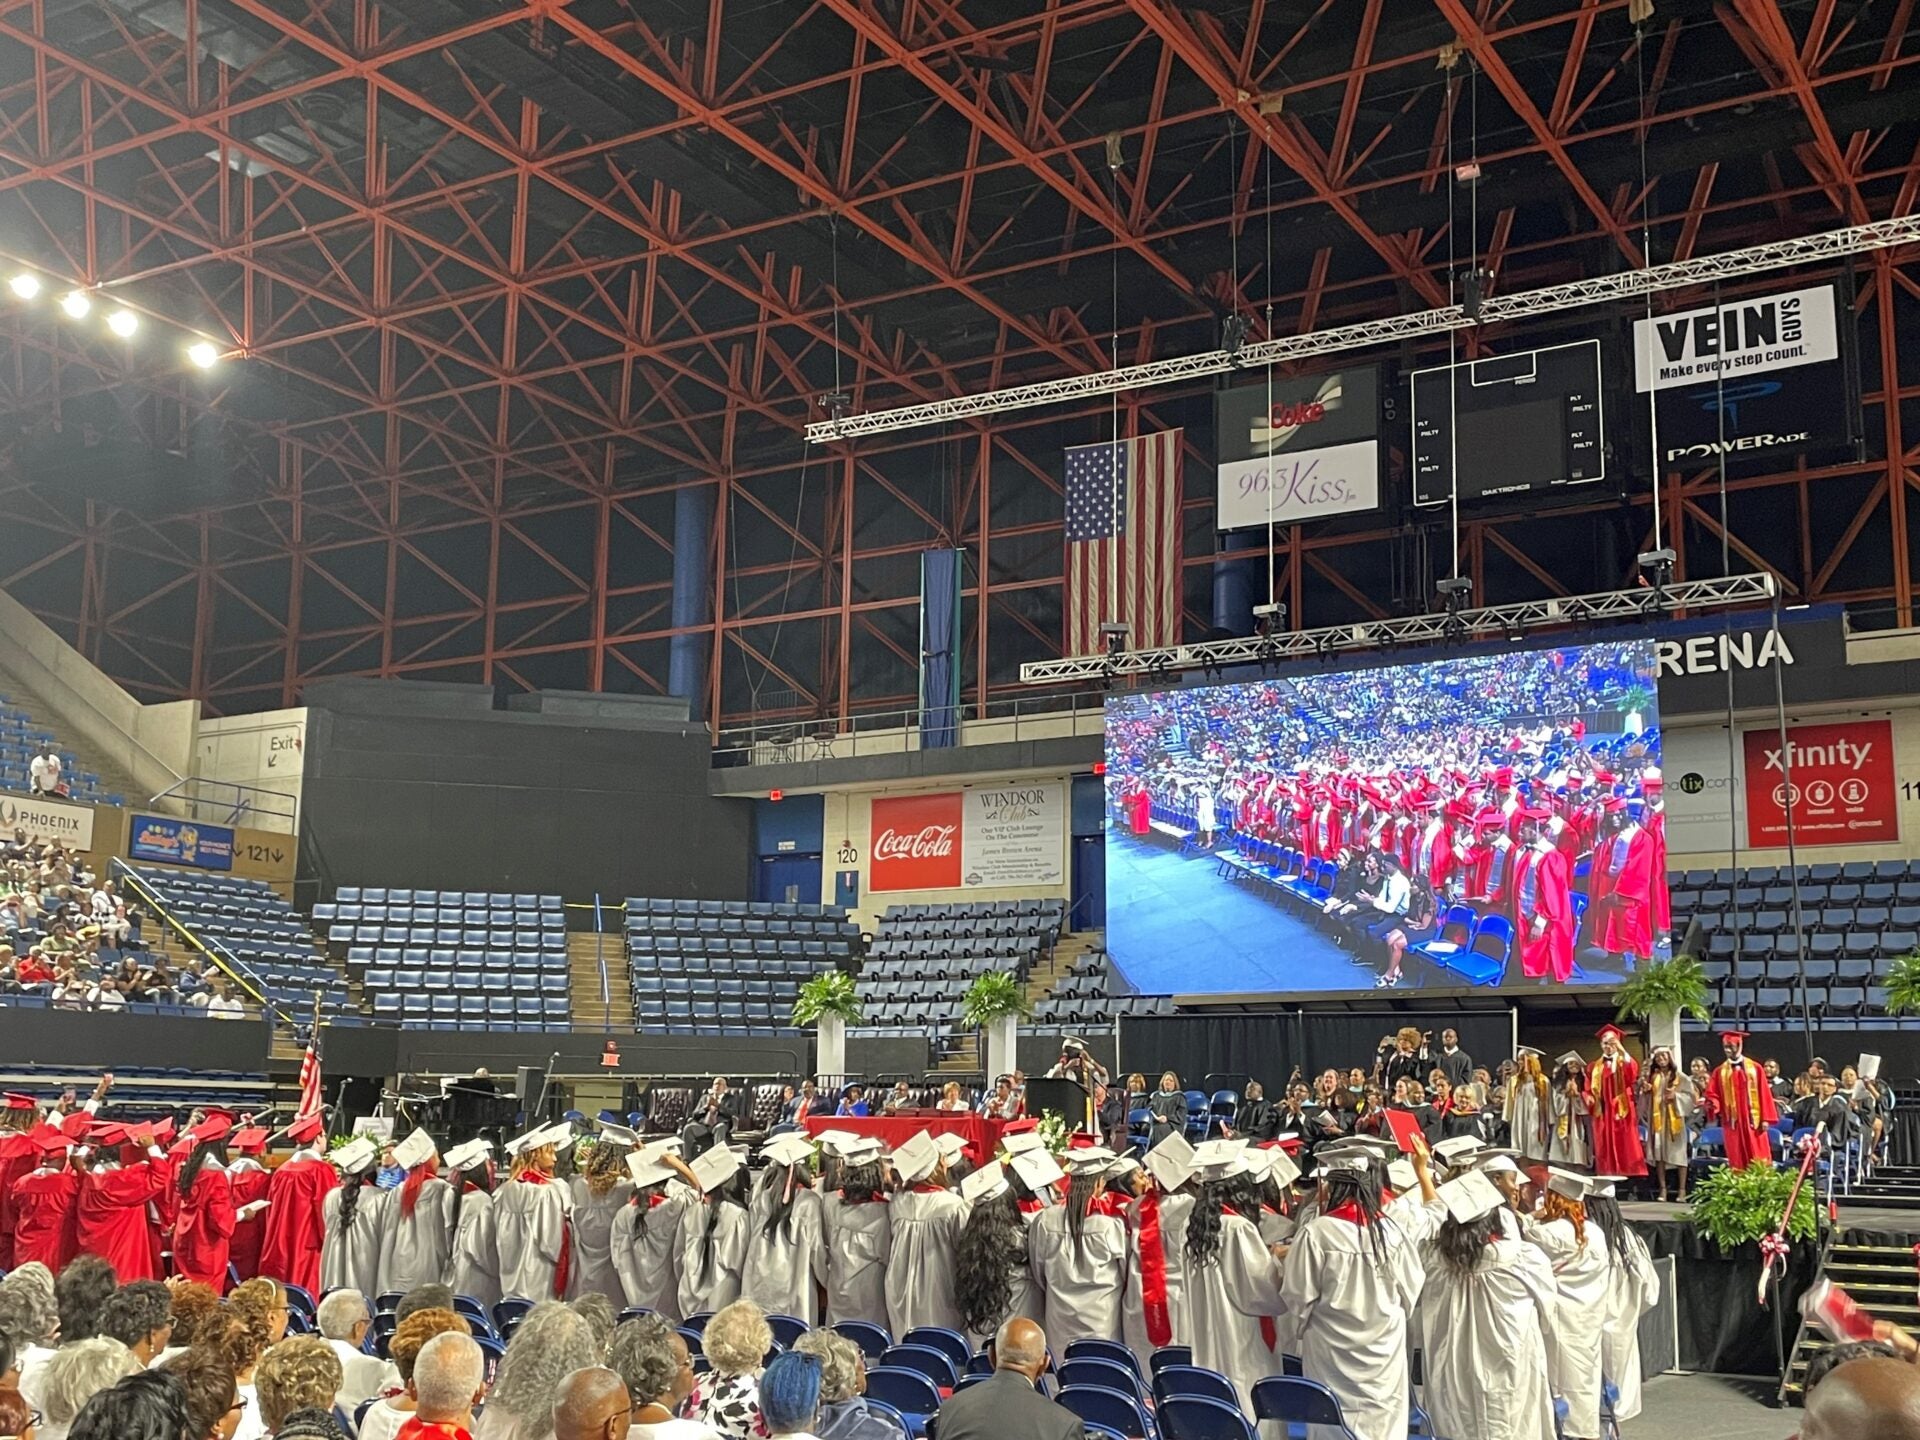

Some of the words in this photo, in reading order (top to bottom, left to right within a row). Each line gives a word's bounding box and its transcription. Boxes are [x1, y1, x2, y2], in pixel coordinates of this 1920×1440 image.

[1656, 302, 1777, 362] VEIN
[1780, 298, 1803, 342] GUYS
[1660, 364, 1693, 380] Make
[1696, 359, 1732, 375] every
[1735, 351, 1763, 368] step
[1270, 401, 1325, 429] Coke
[1265, 459, 1346, 512] Kiss
[271, 735, 293, 751] Exit
[1763, 738, 1872, 773] xfinity
[980, 789, 1045, 808] WINDSOR
[20, 811, 79, 831] PHOENIX
[247, 845, 270, 863] 121
[837, 848, 858, 864] 120
[874, 824, 958, 861] Coca-Cola
